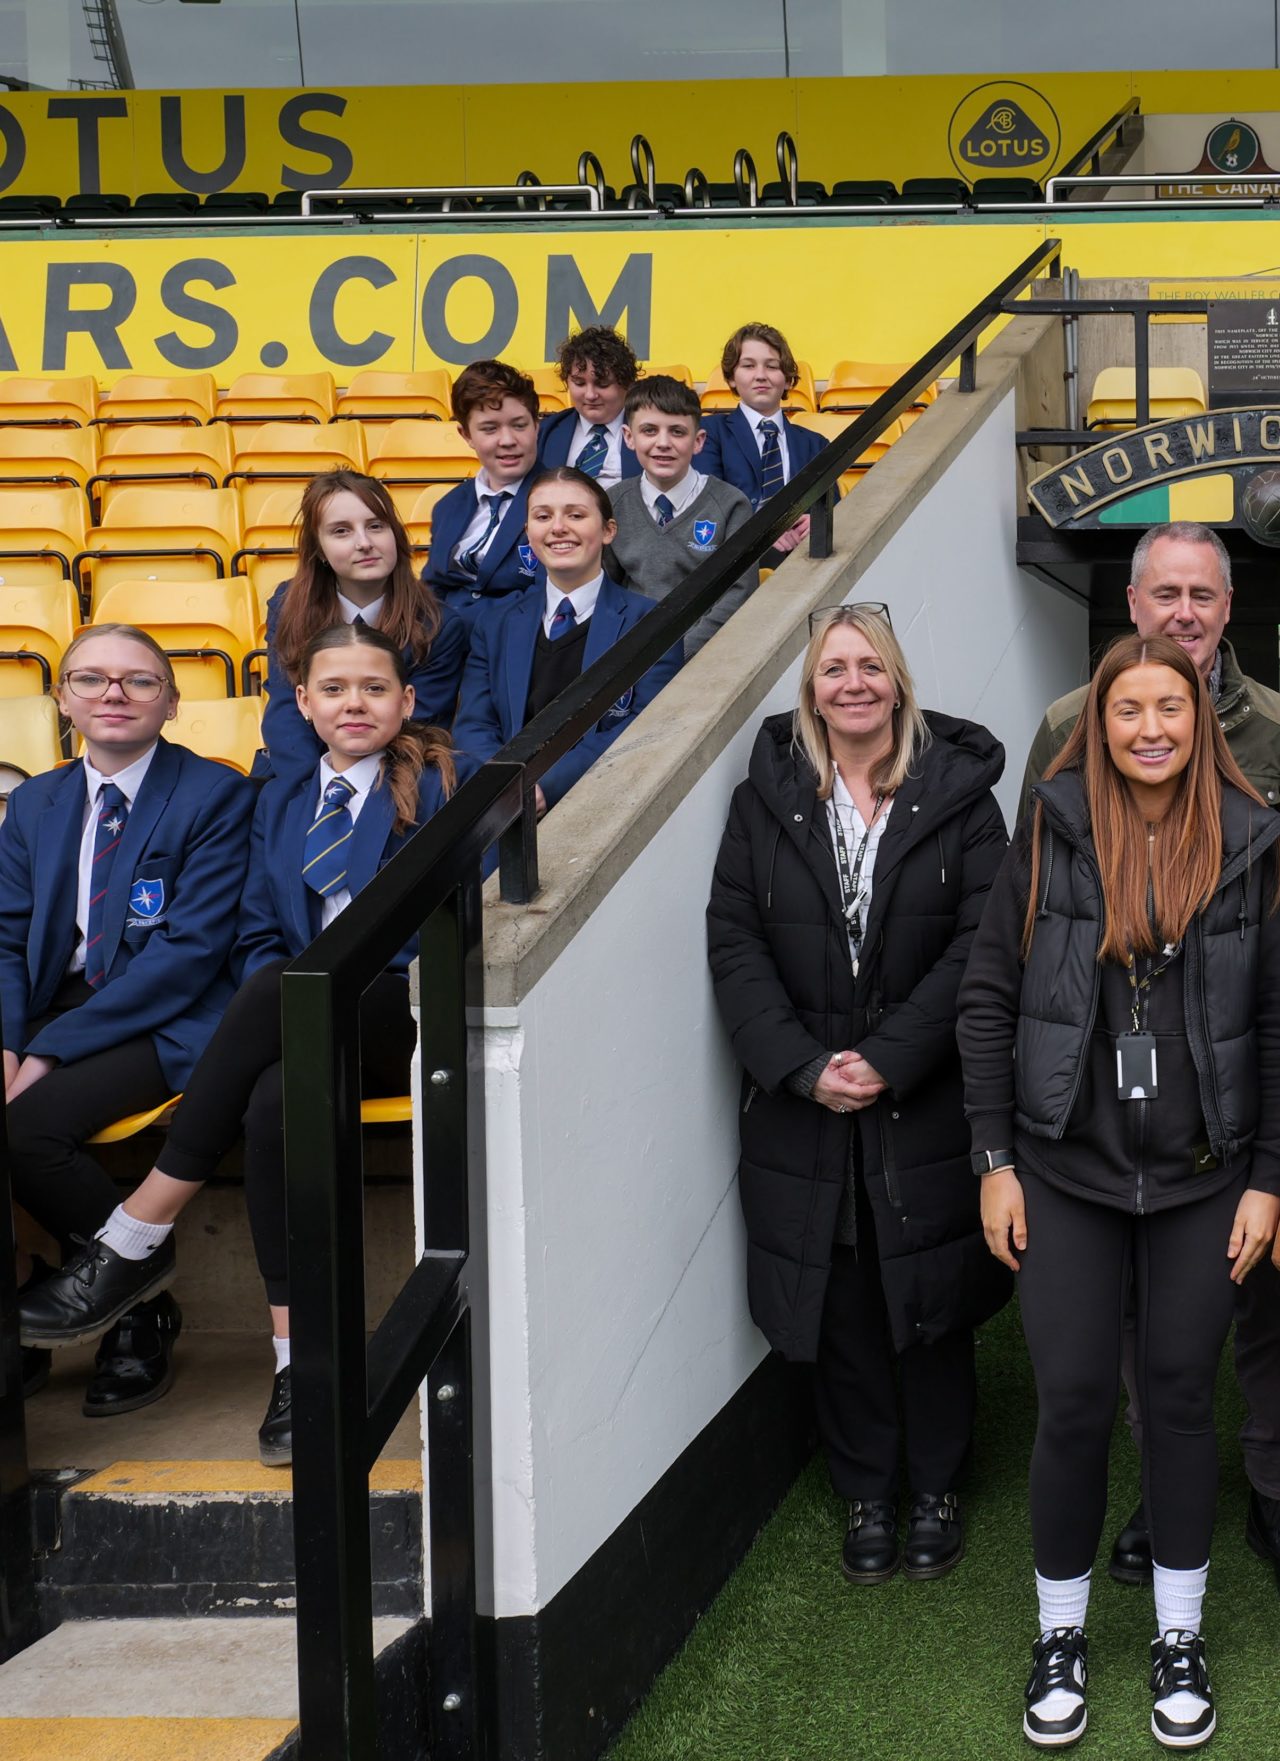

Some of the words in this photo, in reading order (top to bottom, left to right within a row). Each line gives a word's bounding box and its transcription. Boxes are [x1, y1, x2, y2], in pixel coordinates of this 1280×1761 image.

[0, 92, 354, 195] TUS
[967, 138, 1045, 157] LOTUS
[0, 252, 654, 371] RS.COM
[1157, 291, 1181, 300] THE
